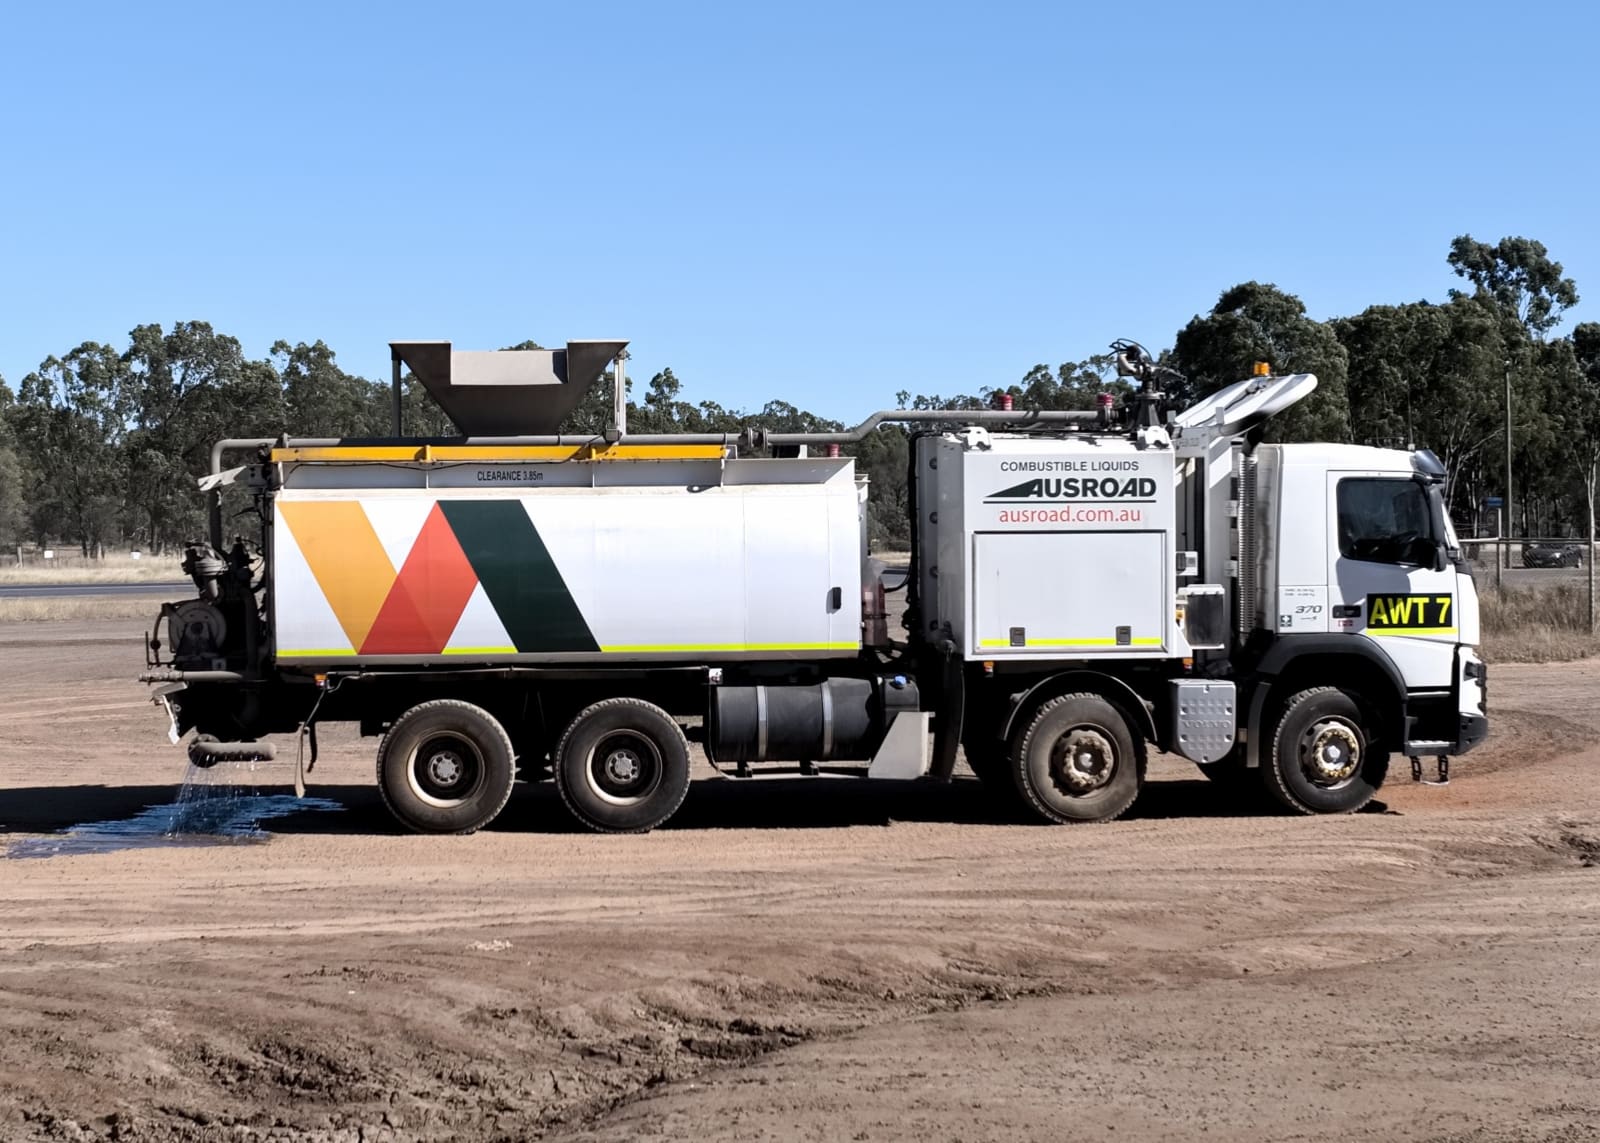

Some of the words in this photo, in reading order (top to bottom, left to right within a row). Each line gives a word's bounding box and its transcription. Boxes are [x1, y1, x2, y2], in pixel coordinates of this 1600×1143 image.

[1000, 461, 1088, 472] COMBUSTIBLE
[1091, 460, 1140, 472] LIQUIDS
[477, 470, 522, 481] CLEARANCE
[985, 477, 1157, 498] AUSROAD
[999, 505, 1141, 523] ausroad.com.au
[1295, 605, 1322, 614] 370
[1369, 597, 1430, 625] AWT
[1436, 597, 1451, 624] 7
